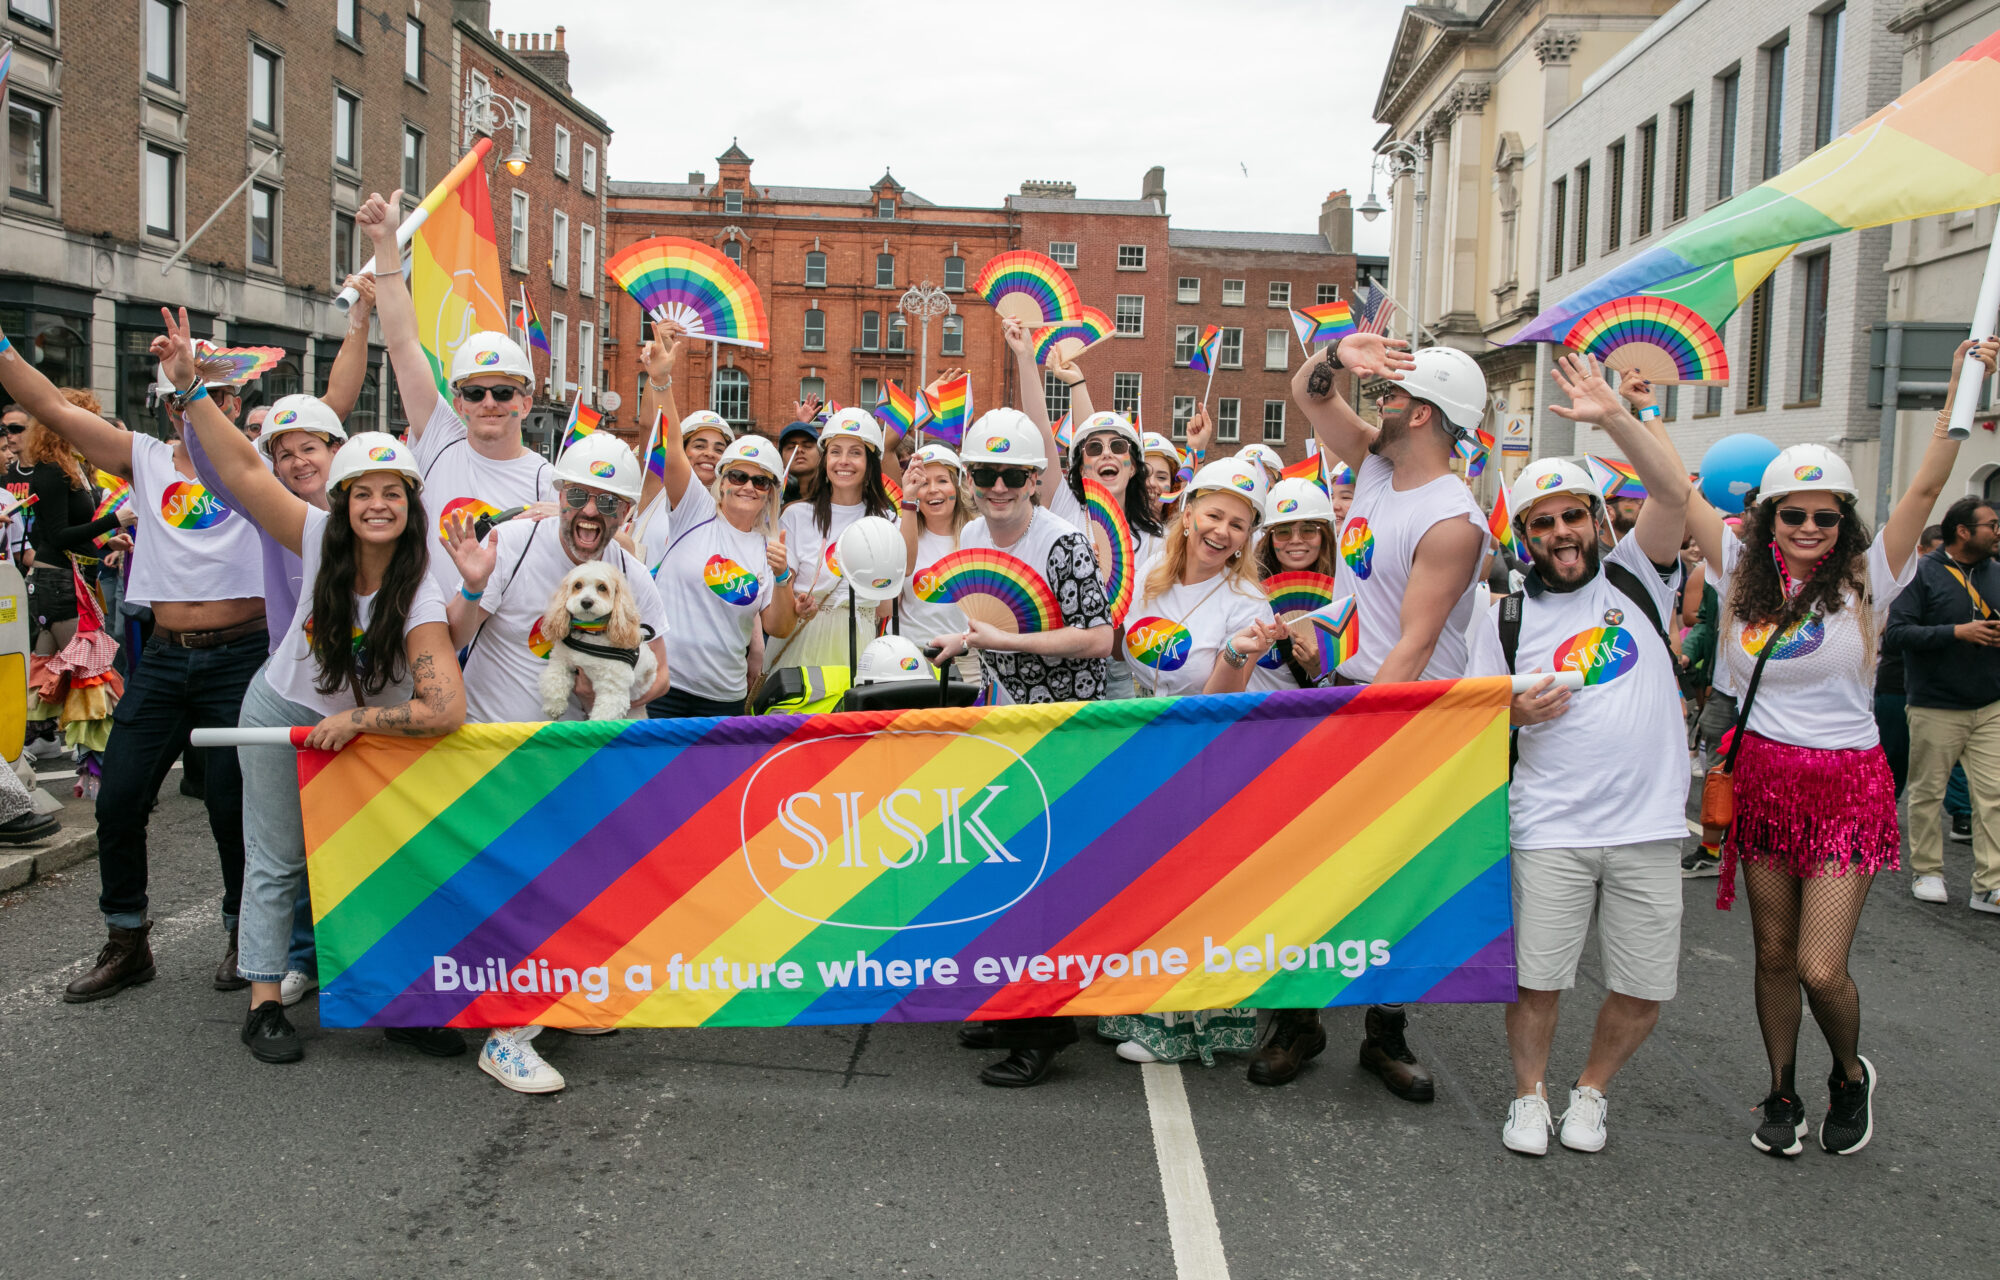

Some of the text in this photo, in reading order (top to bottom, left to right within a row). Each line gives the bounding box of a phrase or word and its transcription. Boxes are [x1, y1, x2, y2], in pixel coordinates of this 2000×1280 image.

[371, 449, 394, 458] SISK
[987, 440, 1009, 450] SISK
[592, 463, 614, 476] SISK
[1796, 470, 1821, 478] SISK
[1538, 475, 1562, 487] SISK
[168, 494, 227, 516] SISK
[709, 561, 755, 599] SISK
[918, 575, 948, 593] SIS
[1132, 625, 1185, 661] SISK
[1562, 635, 1632, 671] SISK
[777, 785, 1022, 870] SISK
[433, 933, 1391, 1003] Building a future where everyone belongs
